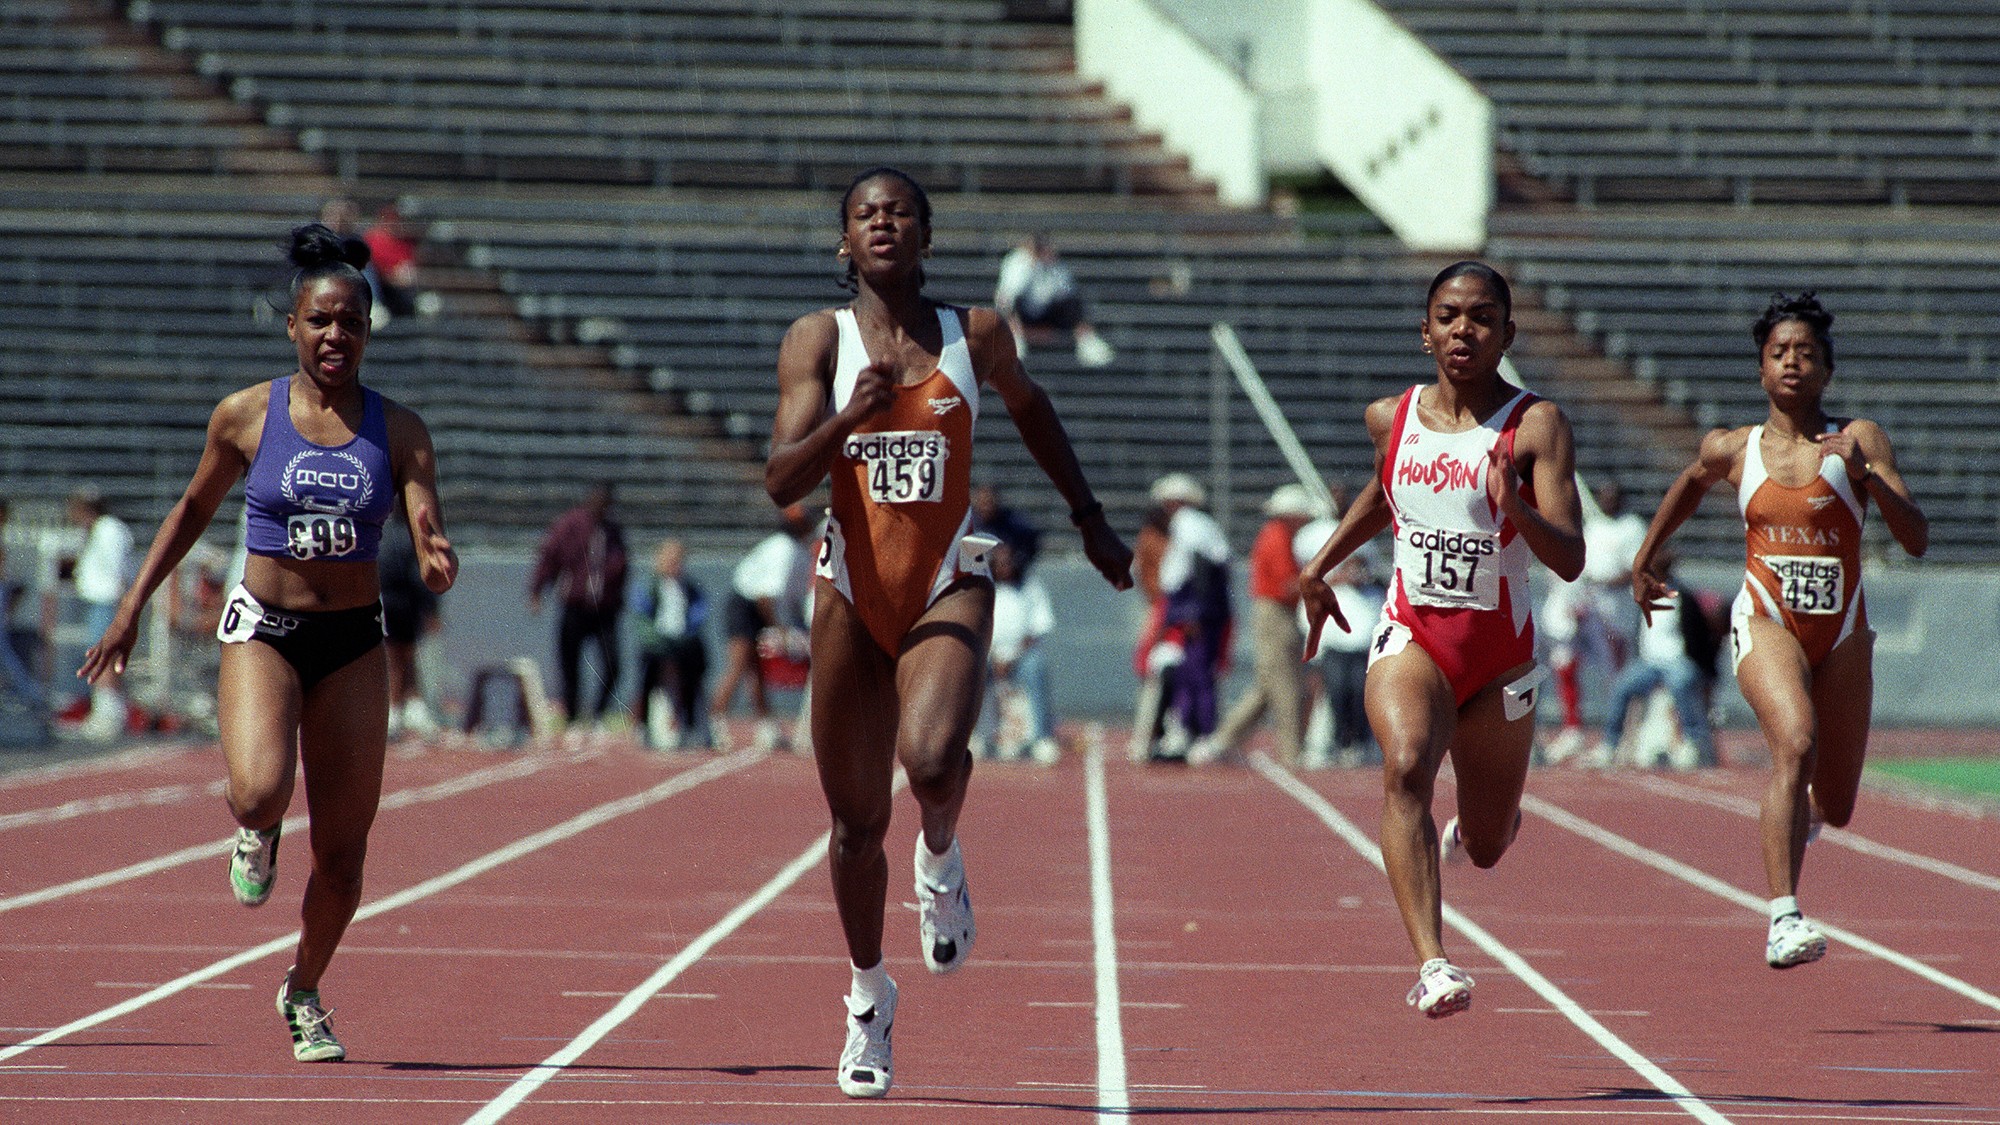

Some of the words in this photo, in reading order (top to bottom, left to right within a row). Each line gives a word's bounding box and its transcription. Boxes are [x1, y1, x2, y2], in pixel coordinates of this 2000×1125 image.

[847, 436, 939, 459] adidas
[296, 469, 359, 490] TCU
[873, 459, 936, 500] 459
[1410, 528, 1494, 555] adidas
[1763, 525, 1841, 546] TEXAS
[1421, 551, 1480, 592] 157
[1785, 579, 1837, 610] 453
